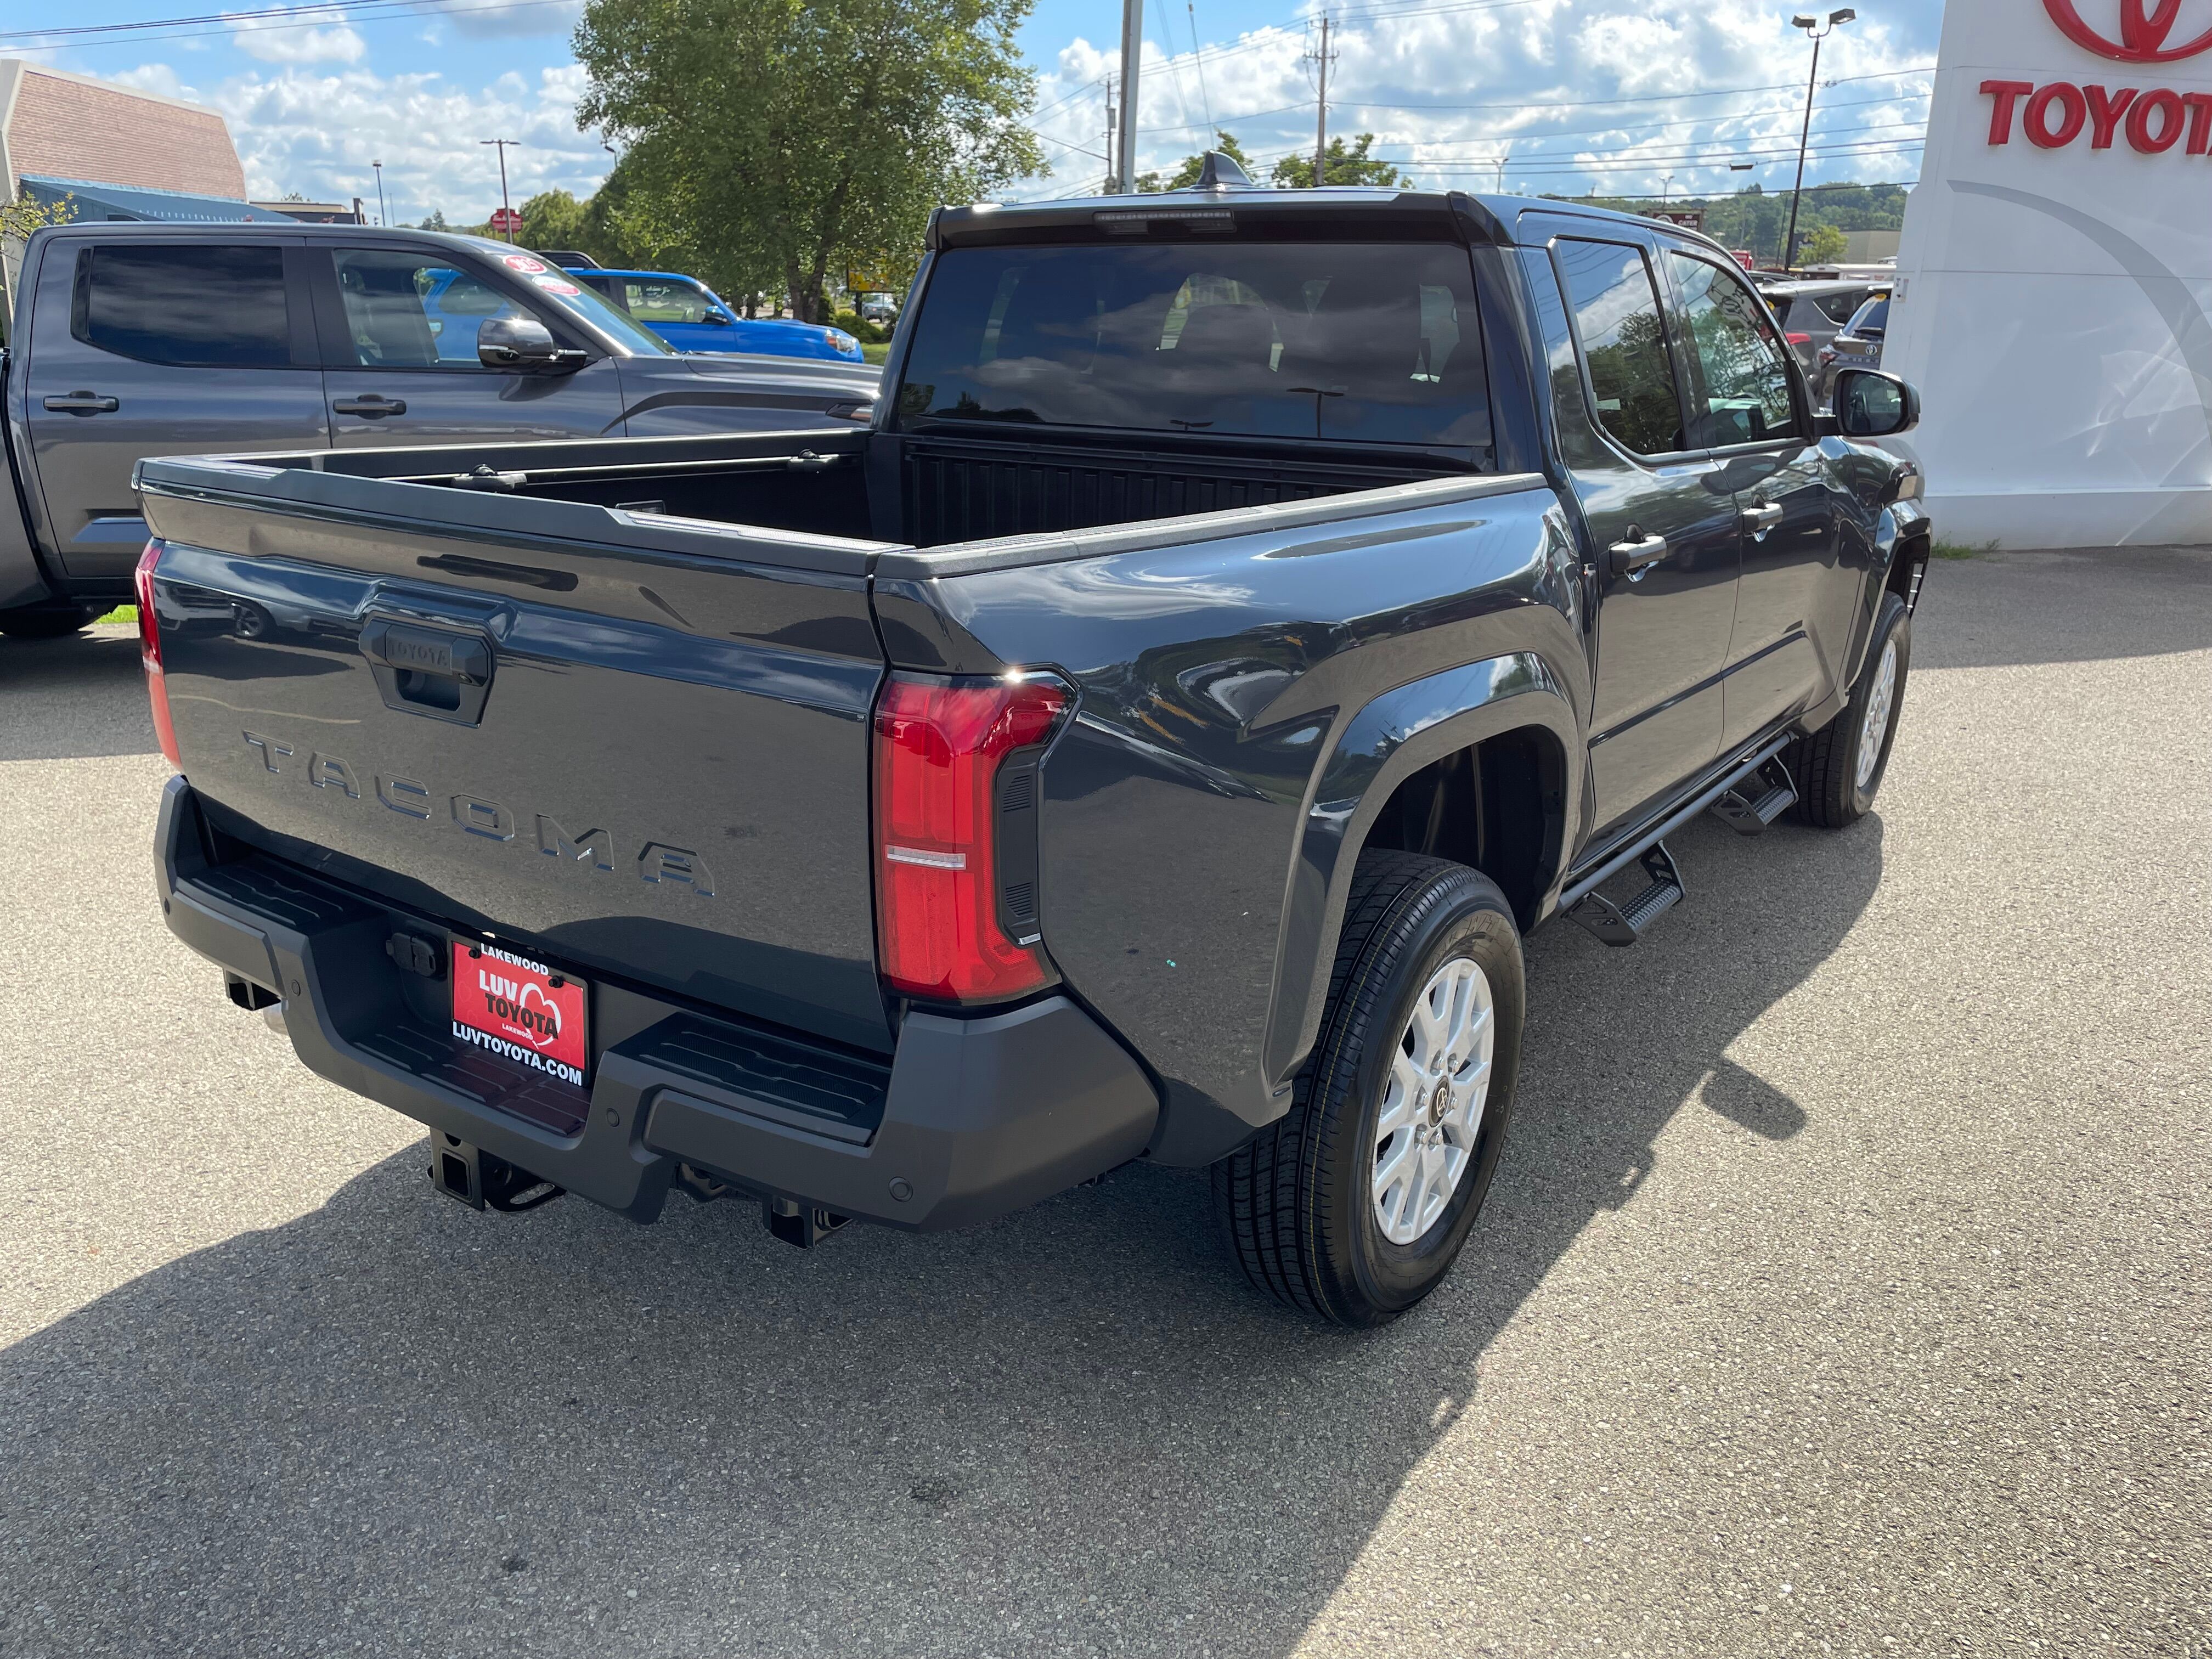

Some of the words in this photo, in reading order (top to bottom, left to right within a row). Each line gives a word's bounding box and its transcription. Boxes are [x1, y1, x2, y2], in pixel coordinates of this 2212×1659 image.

[1979, 80, 2212, 156] TOYOT
[388, 639, 447, 666] TOYOTA
[243, 730, 715, 897] TACOMA
[481, 943, 549, 976] LAKEWOOD
[479, 969, 518, 1002] LUV
[485, 993, 558, 1040] TOYOTA
[502, 1023, 533, 1041] LAKEWOOD
[453, 1021, 582, 1086] LUVTOYOTA.COM
